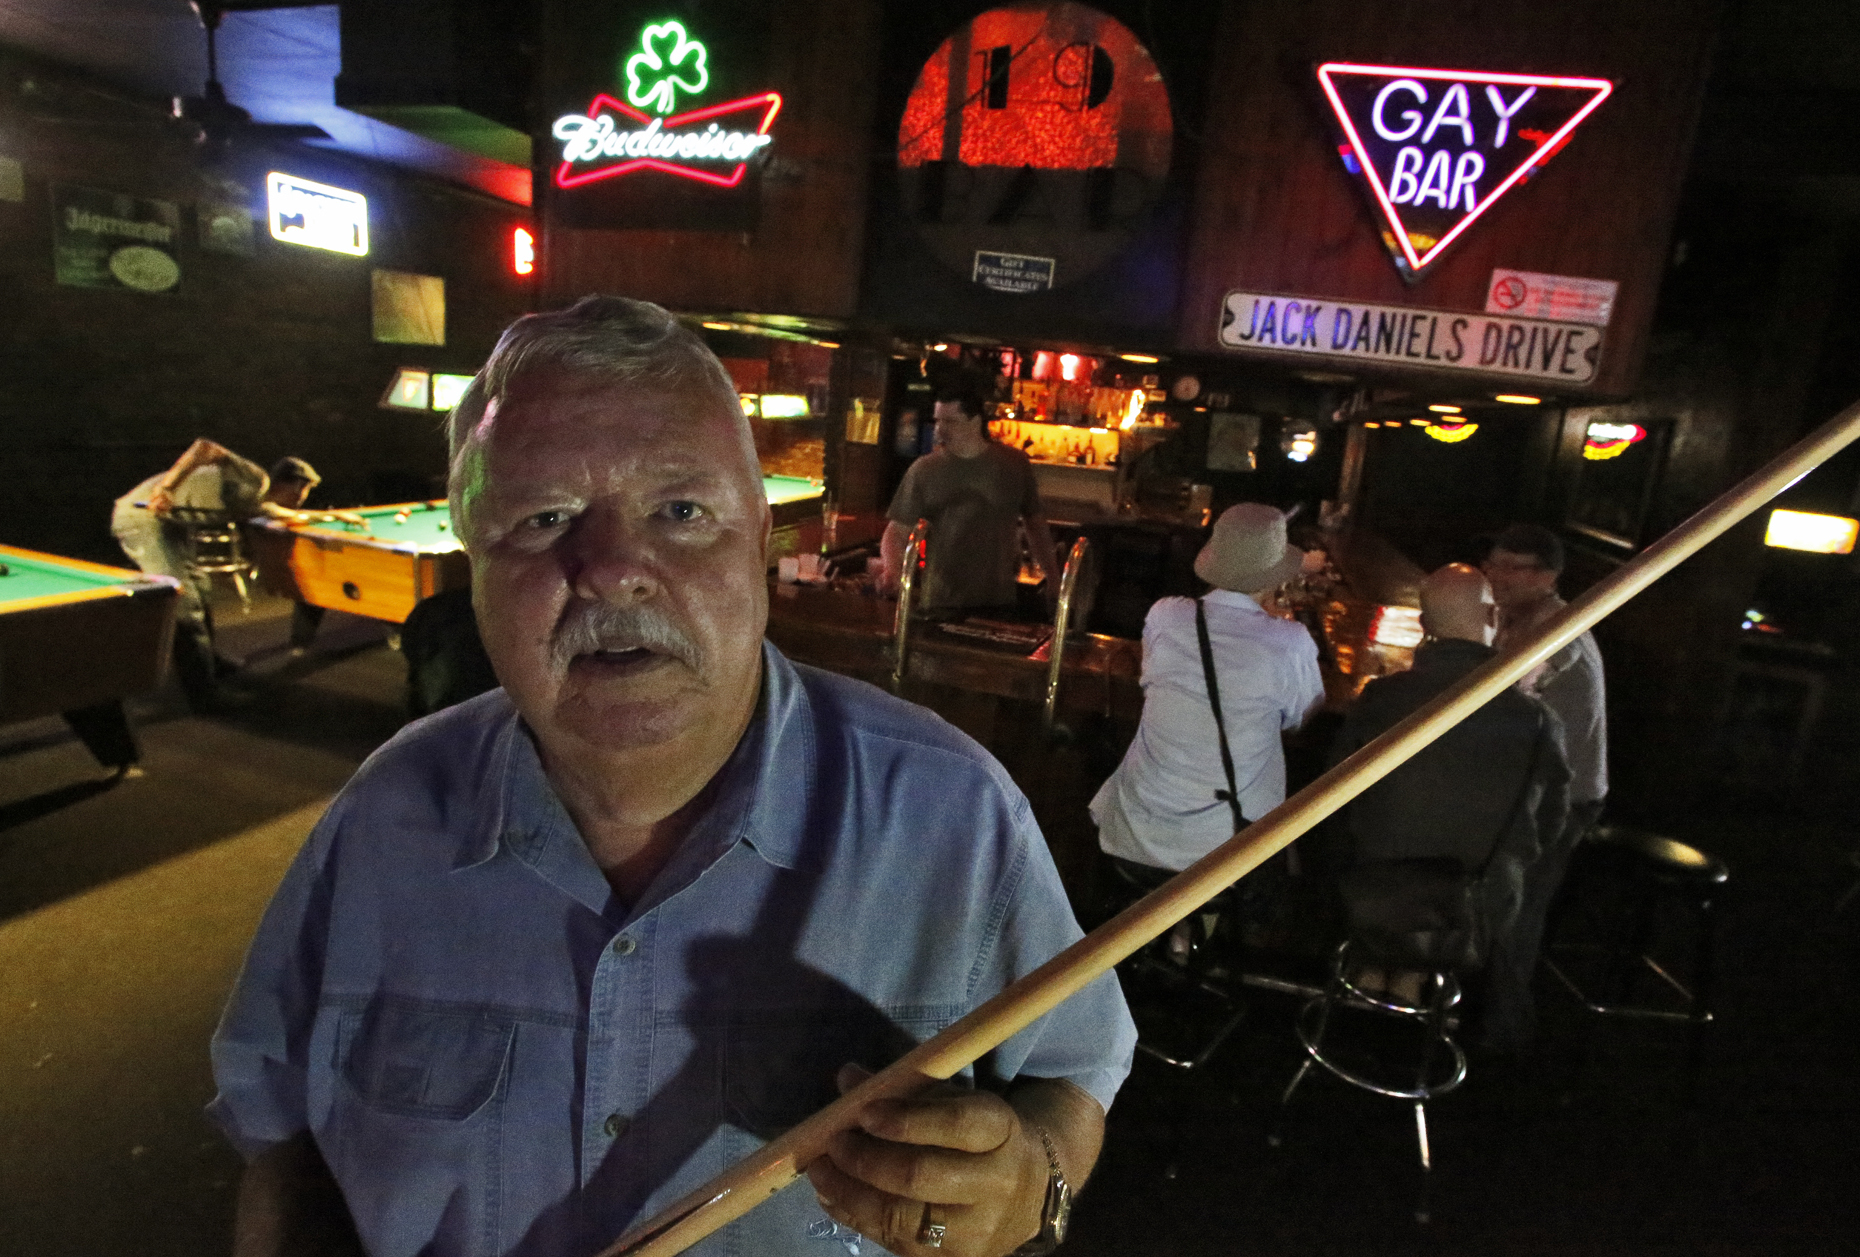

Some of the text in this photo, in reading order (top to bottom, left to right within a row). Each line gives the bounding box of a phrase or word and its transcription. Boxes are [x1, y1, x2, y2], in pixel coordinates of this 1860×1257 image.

[973, 41, 1115, 113] 19
[552, 113, 773, 163] Budweiser
[1371, 78, 1537, 149] GAY
[1389, 145, 1486, 213] BAR
[1239, 299, 1585, 375] JACK DANIELS DRIVE
